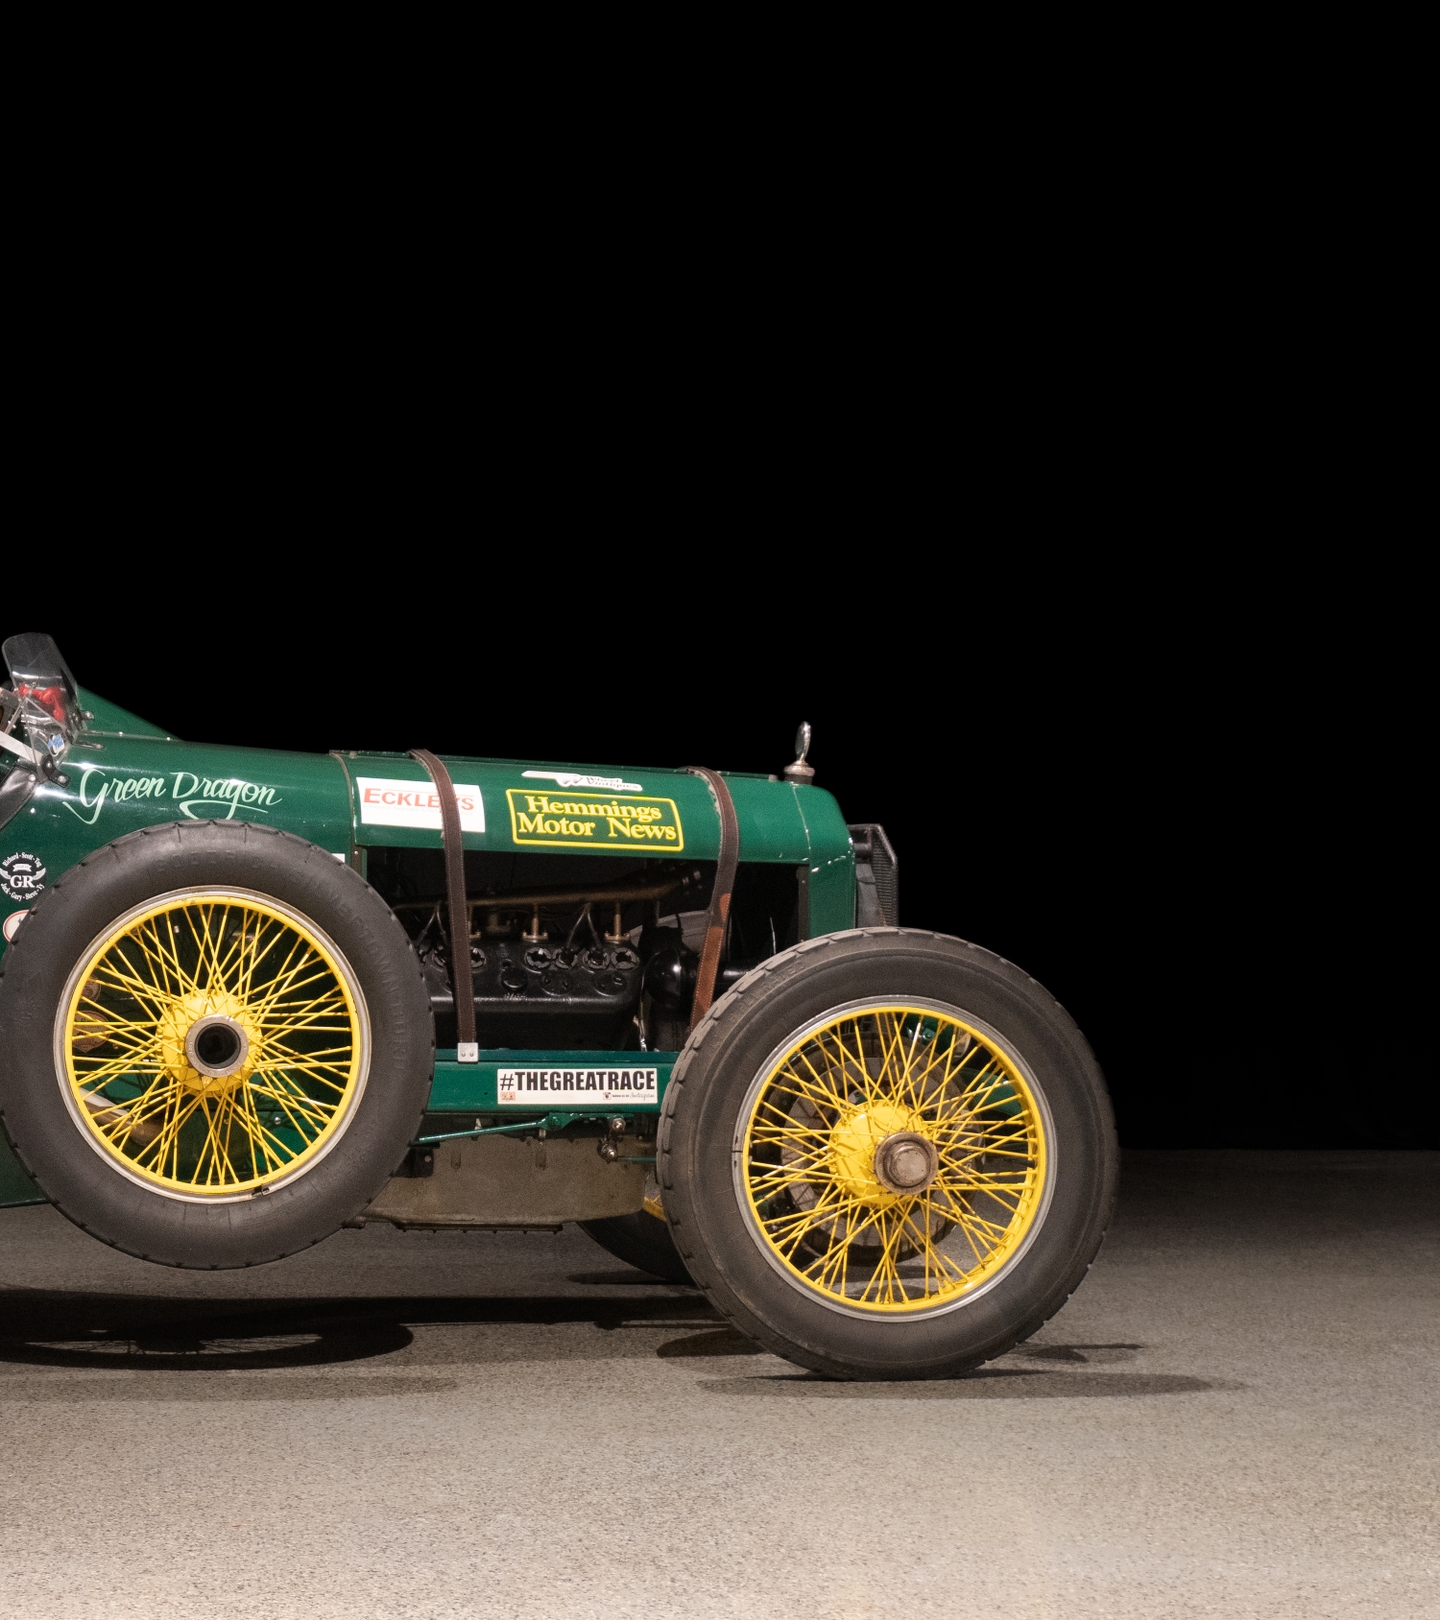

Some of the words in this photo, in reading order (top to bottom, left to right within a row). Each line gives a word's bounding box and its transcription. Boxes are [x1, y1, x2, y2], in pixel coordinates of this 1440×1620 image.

[62, 767, 167, 825] Green
[170, 771, 283, 820] Dragon
[364, 787, 475, 811] ECKLE'S
[524, 795, 663, 824] Hemmings
[516, 812, 596, 837] Motor
[606, 817, 678, 841] News
[10, 874, 36, 888] GR
[500, 1070, 655, 1091] #THEGREATRACE
